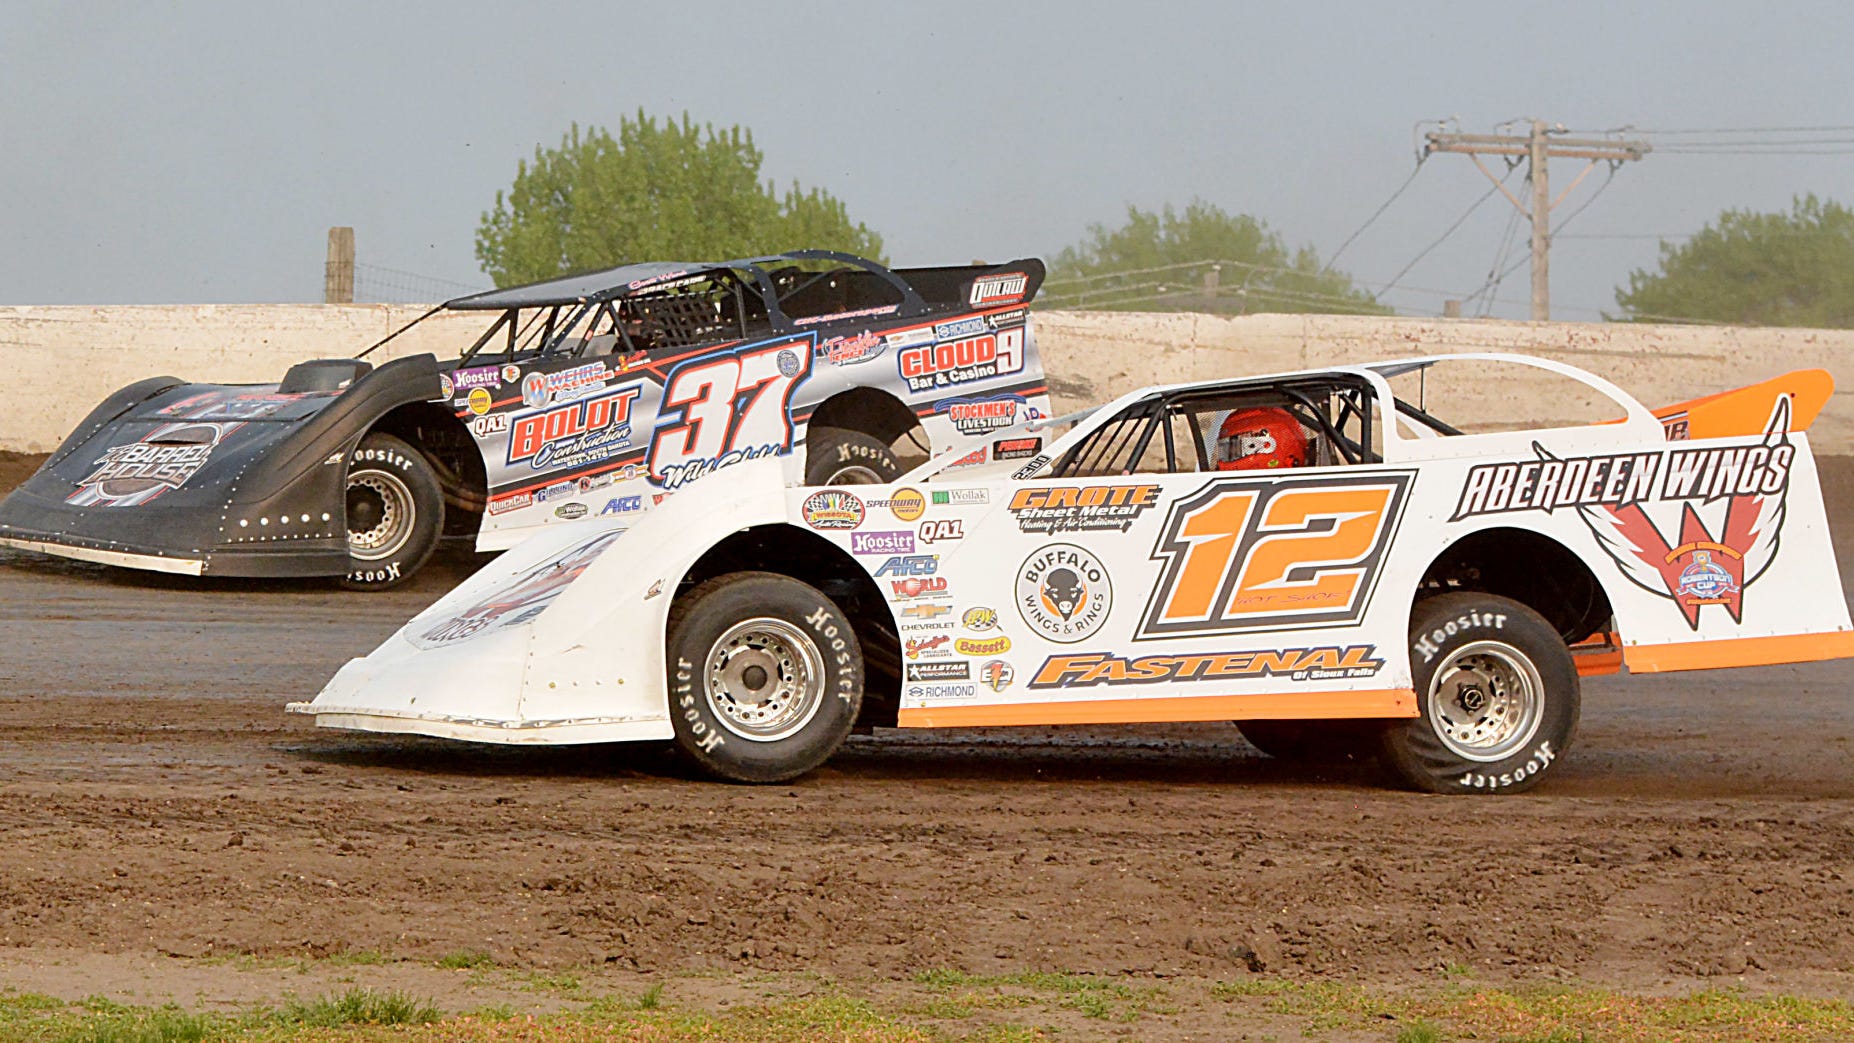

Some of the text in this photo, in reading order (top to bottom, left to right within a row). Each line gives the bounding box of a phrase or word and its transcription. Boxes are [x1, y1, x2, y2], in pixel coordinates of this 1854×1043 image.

[970, 277, 1027, 304] OUTLAW
[900, 326, 1024, 379] CLOUD 9
[455, 370, 499, 387] Hoosier
[908, 365, 996, 390] Bar & Casino
[650, 339, 813, 480] 37
[950, 402, 1016, 420] STOCKMEN'S
[474, 414, 507, 438] QA1
[508, 390, 640, 462] BOLDT
[957, 415, 1013, 430] LIVESTOCK
[530, 422, 631, 470] Construction
[350, 448, 413, 471] oosier
[952, 489, 987, 500] Wollak
[1454, 445, 1794, 520] ABERDEEN WINGS
[600, 496, 641, 515] AFCO
[866, 498, 922, 508] SPEEDWAY
[1009, 485, 1162, 510] GROTE
[1018, 505, 1138, 519] Sheet Metal
[919, 520, 964, 544] QA1
[1021, 519, 1053, 532] Heating
[1063, 518, 1078, 528] Air
[854, 532, 914, 551] Hoosier
[1160, 483, 1402, 622] 12
[872, 555, 939, 578] AFCO
[1025, 551, 1101, 584] BUFFALO
[891, 577, 948, 597] WORLD
[1025, 593, 1104, 634] WINGS & RINGS
[901, 622, 955, 632] CHEVROLET
[1414, 609, 1507, 663] Hoosier
[805, 606, 853, 703] Hoosier
[960, 640, 1006, 653] Bassett
[919, 664, 966, 672] ALLSTAR
[1028, 647, 1377, 688] FASTENAL
[1293, 668, 1375, 679] Of Sioux Falls
[926, 686, 975, 697] RICHMOND
[675, 657, 726, 753] Hoosier
[1460, 741, 1555, 790] Hoosier
